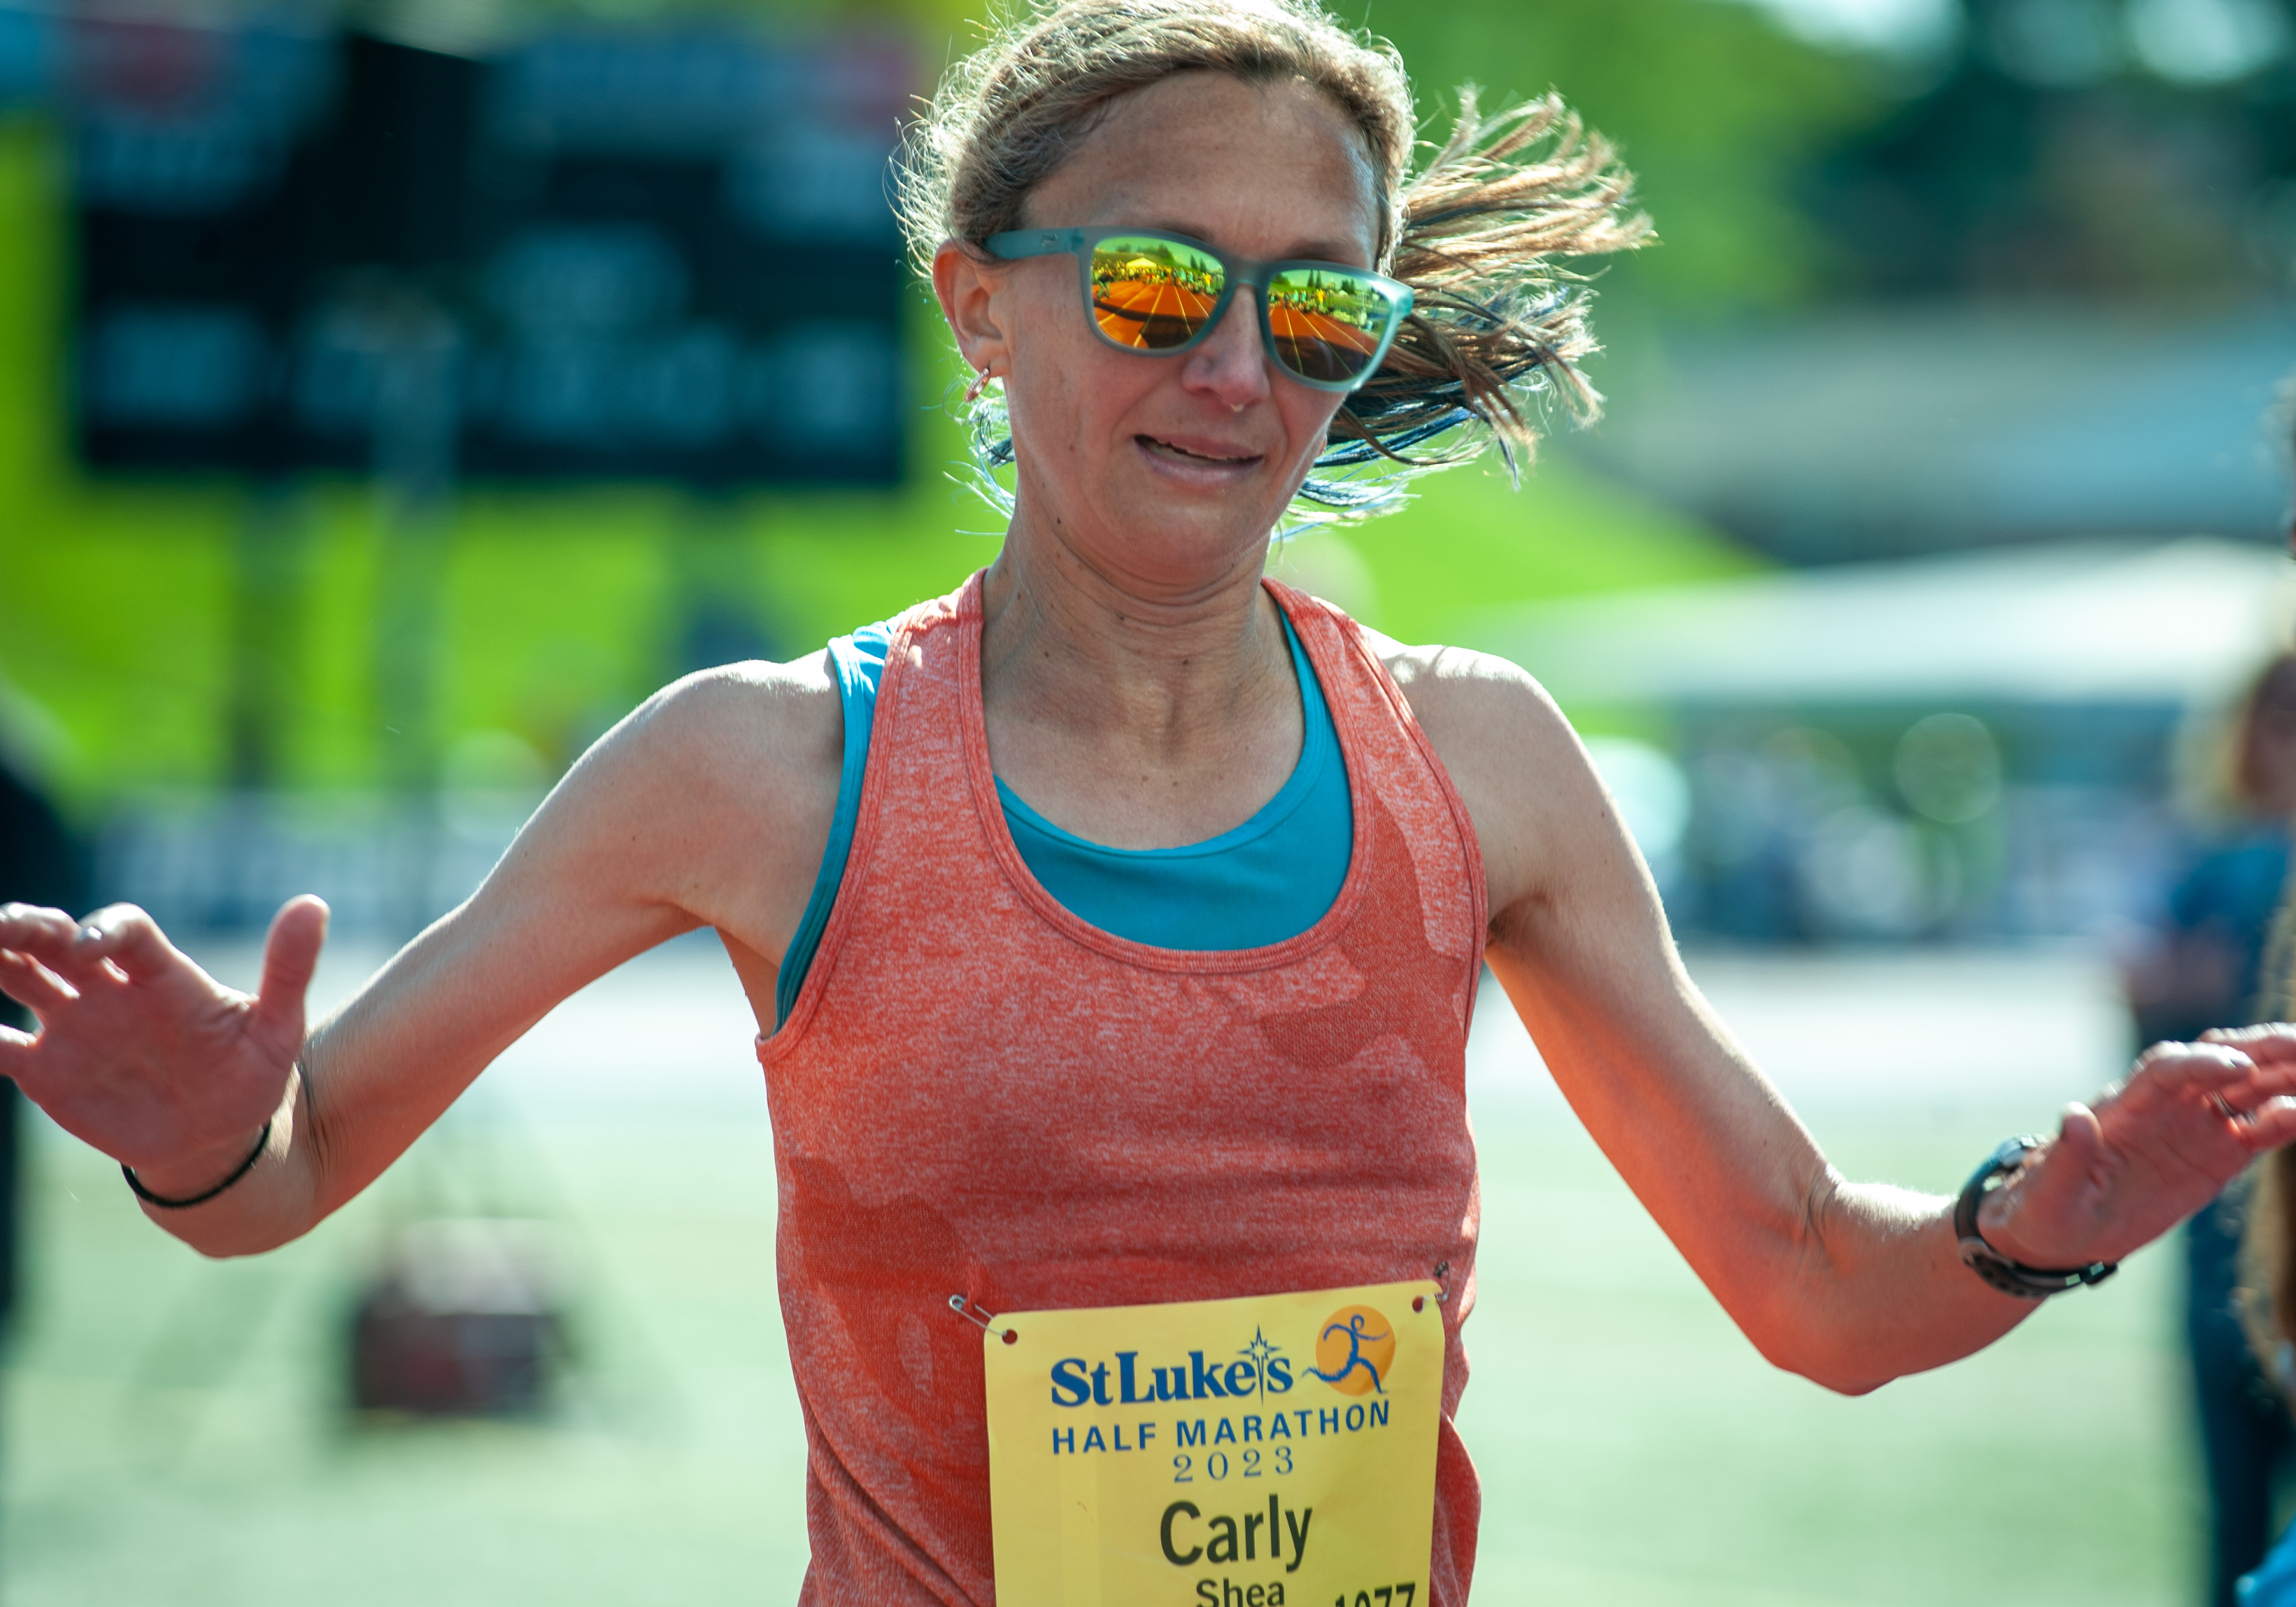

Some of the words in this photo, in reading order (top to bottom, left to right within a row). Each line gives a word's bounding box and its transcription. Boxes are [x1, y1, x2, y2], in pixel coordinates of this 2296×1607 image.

[1053, 1422, 1156, 1454] HALF
[1176, 1399, 1390, 1448] MARATHON
[1174, 1445, 1294, 1482] 2023
[1160, 1493, 1313, 1574] Carly
[1196, 1577, 1285, 1607] Shea
